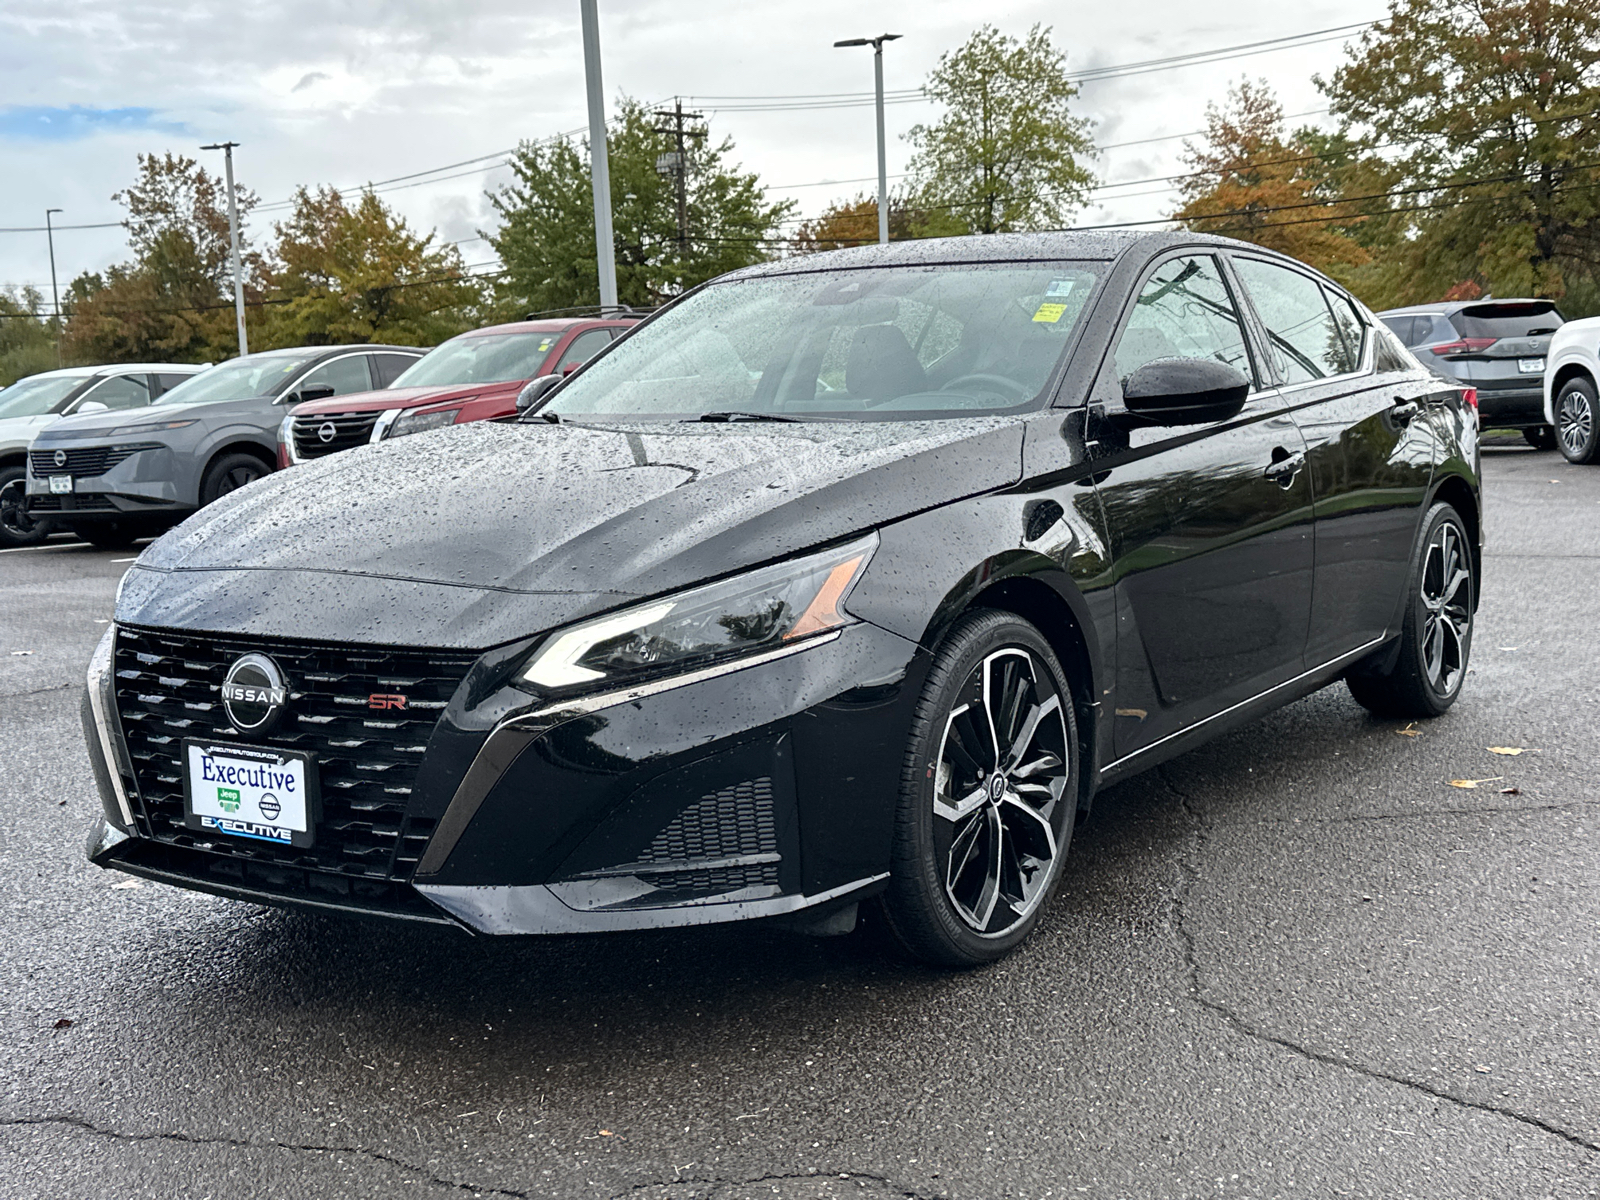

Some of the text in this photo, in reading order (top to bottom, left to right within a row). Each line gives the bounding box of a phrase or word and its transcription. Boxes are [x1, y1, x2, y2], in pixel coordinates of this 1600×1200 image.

[222, 686, 284, 704] NISSAN
[368, 693, 409, 711] SR
[201, 755, 295, 792] Executive
[220, 788, 238, 801] Jeep
[201, 816, 292, 841] EXECUTIVE
